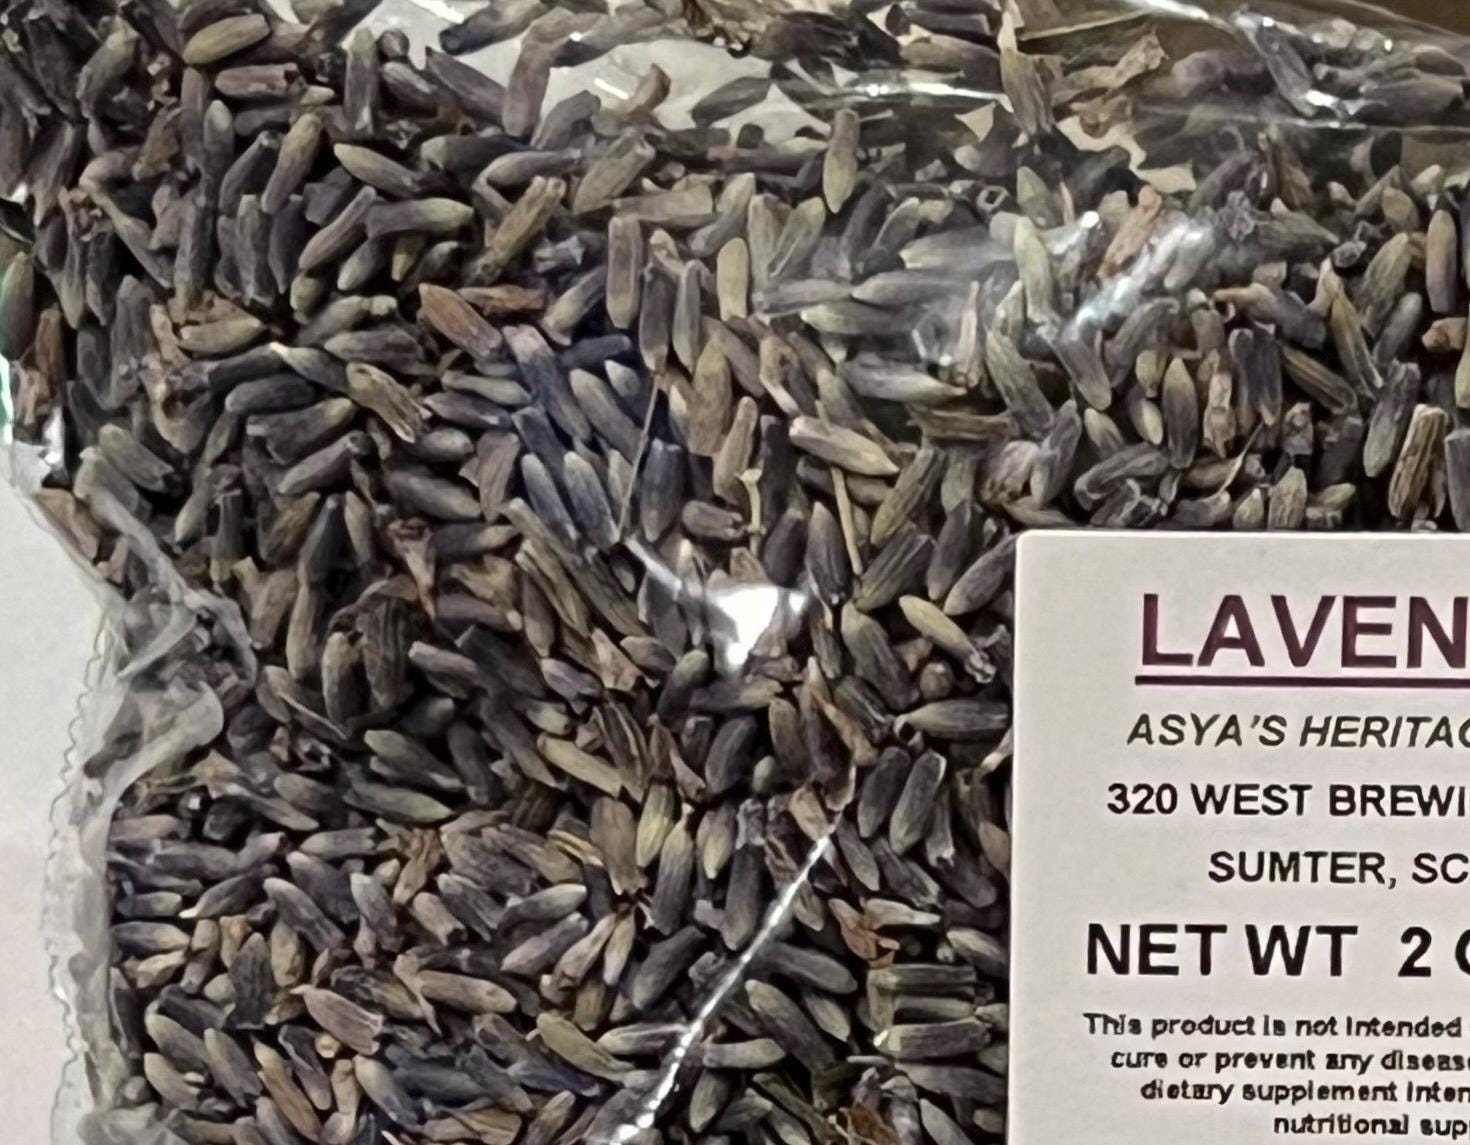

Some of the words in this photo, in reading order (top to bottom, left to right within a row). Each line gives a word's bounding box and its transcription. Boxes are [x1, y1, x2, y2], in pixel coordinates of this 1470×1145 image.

[1106, 782, 1178, 815] 320
[1190, 782, 1313, 817] WEST
[1208, 850, 1397, 890] SUMTER,
[1411, 852, 1469, 885] SC
[1087, 922, 1228, 976] NET
[1244, 923, 1359, 977] WT
[1397, 926, 1433, 978] 2
[1082, 1012, 1142, 1036] This
[1151, 1014, 1256, 1040] product
[1263, 1014, 1286, 1037] is
[1295, 1015, 1339, 1037] not
[1346, 1015, 1462, 1038] intended
[1110, 1051, 1168, 1069] cure
[1178, 1052, 1208, 1069] or
[1215, 1049, 1316, 1074] prevent
[1325, 1053, 1375, 1076] any
[1139, 1079, 1235, 1106] dietary
[1242, 1079, 1398, 1106] supplement
[1273, 1113, 1410, 1135] nutritional
